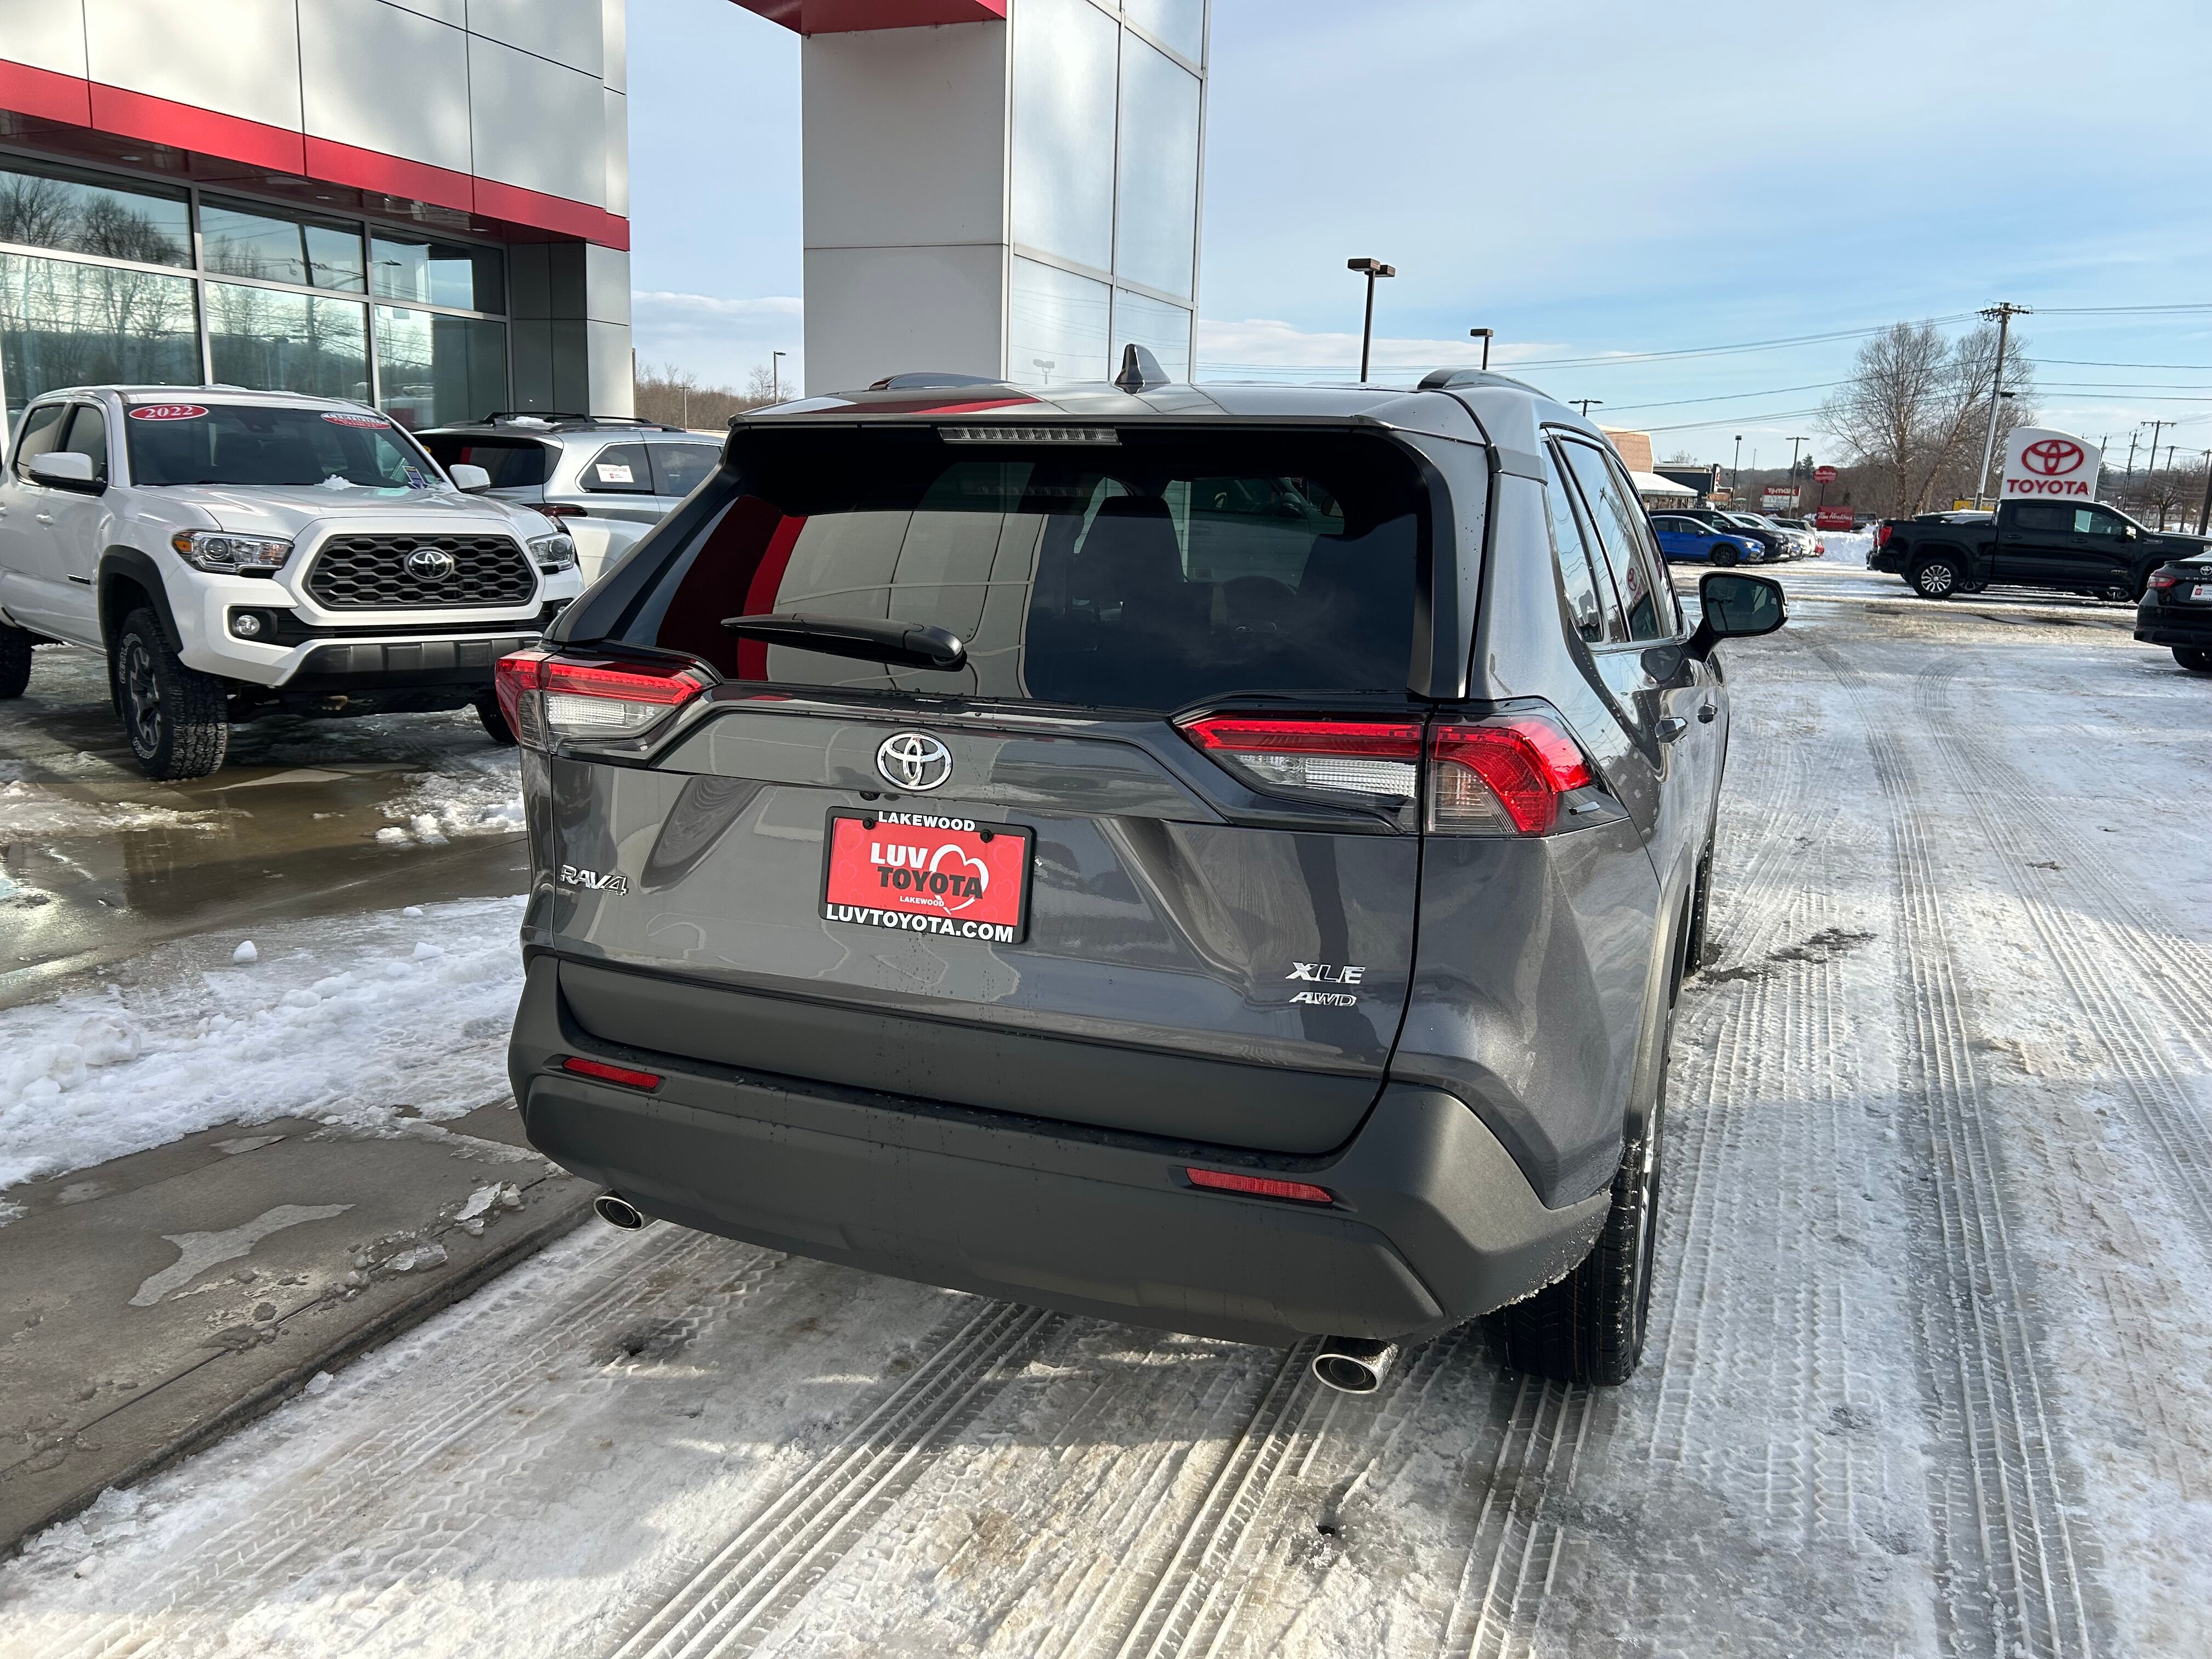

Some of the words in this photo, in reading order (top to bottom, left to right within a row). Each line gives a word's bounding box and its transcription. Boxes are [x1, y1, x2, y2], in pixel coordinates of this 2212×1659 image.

[144, 406, 194, 418] 2022
[2007, 479, 2090, 496] TOYOTA
[878, 811, 976, 832] LAKEWOOD
[870, 842, 928, 869] LUV
[561, 864, 628, 896] RAV4
[878, 866, 984, 899] TOYOTA
[899, 895, 945, 907] LAKEWOOD
[826, 904, 1013, 943] LUVTOYOTA.COM
[1285, 961, 1366, 984] XLE
[1289, 991, 1357, 1007] AWD
